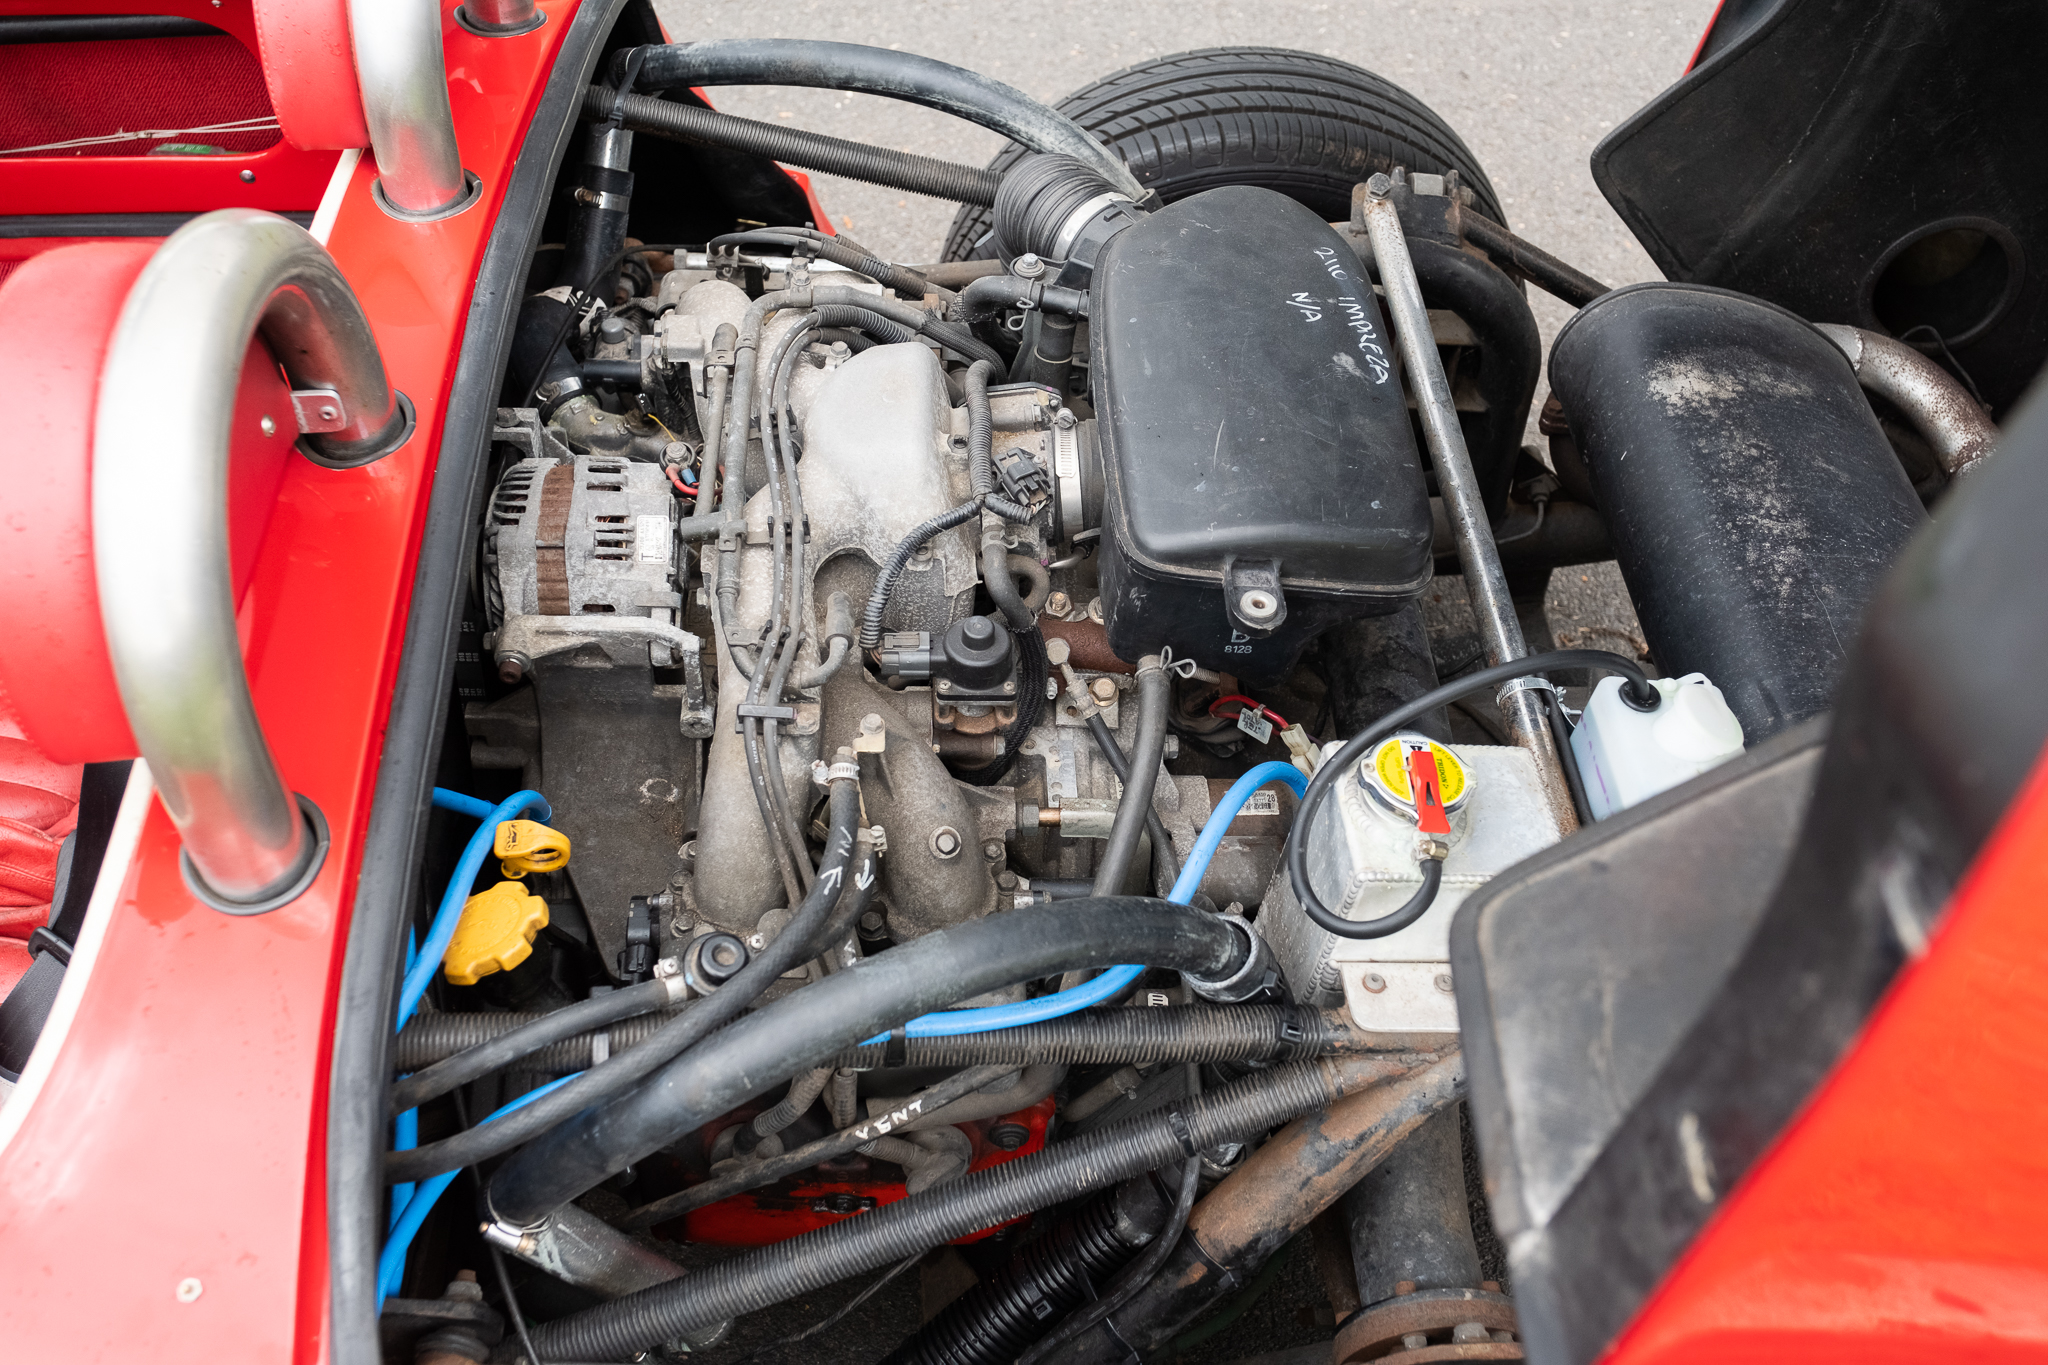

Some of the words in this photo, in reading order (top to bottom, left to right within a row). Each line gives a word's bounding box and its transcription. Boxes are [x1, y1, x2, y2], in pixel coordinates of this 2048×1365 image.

[1285, 291, 1323, 323] N/A
[1338, 296, 1390, 385] IMPREZA
[1224, 645, 1253, 654] 8128
[1434, 746, 1445, 755] LIFT
[1444, 754, 1458, 769] LEVER
[1453, 777, 1463, 795] RELEASE
[1436, 758, 1448, 784] TRIDON
[855, 1099, 922, 1139] VENT
